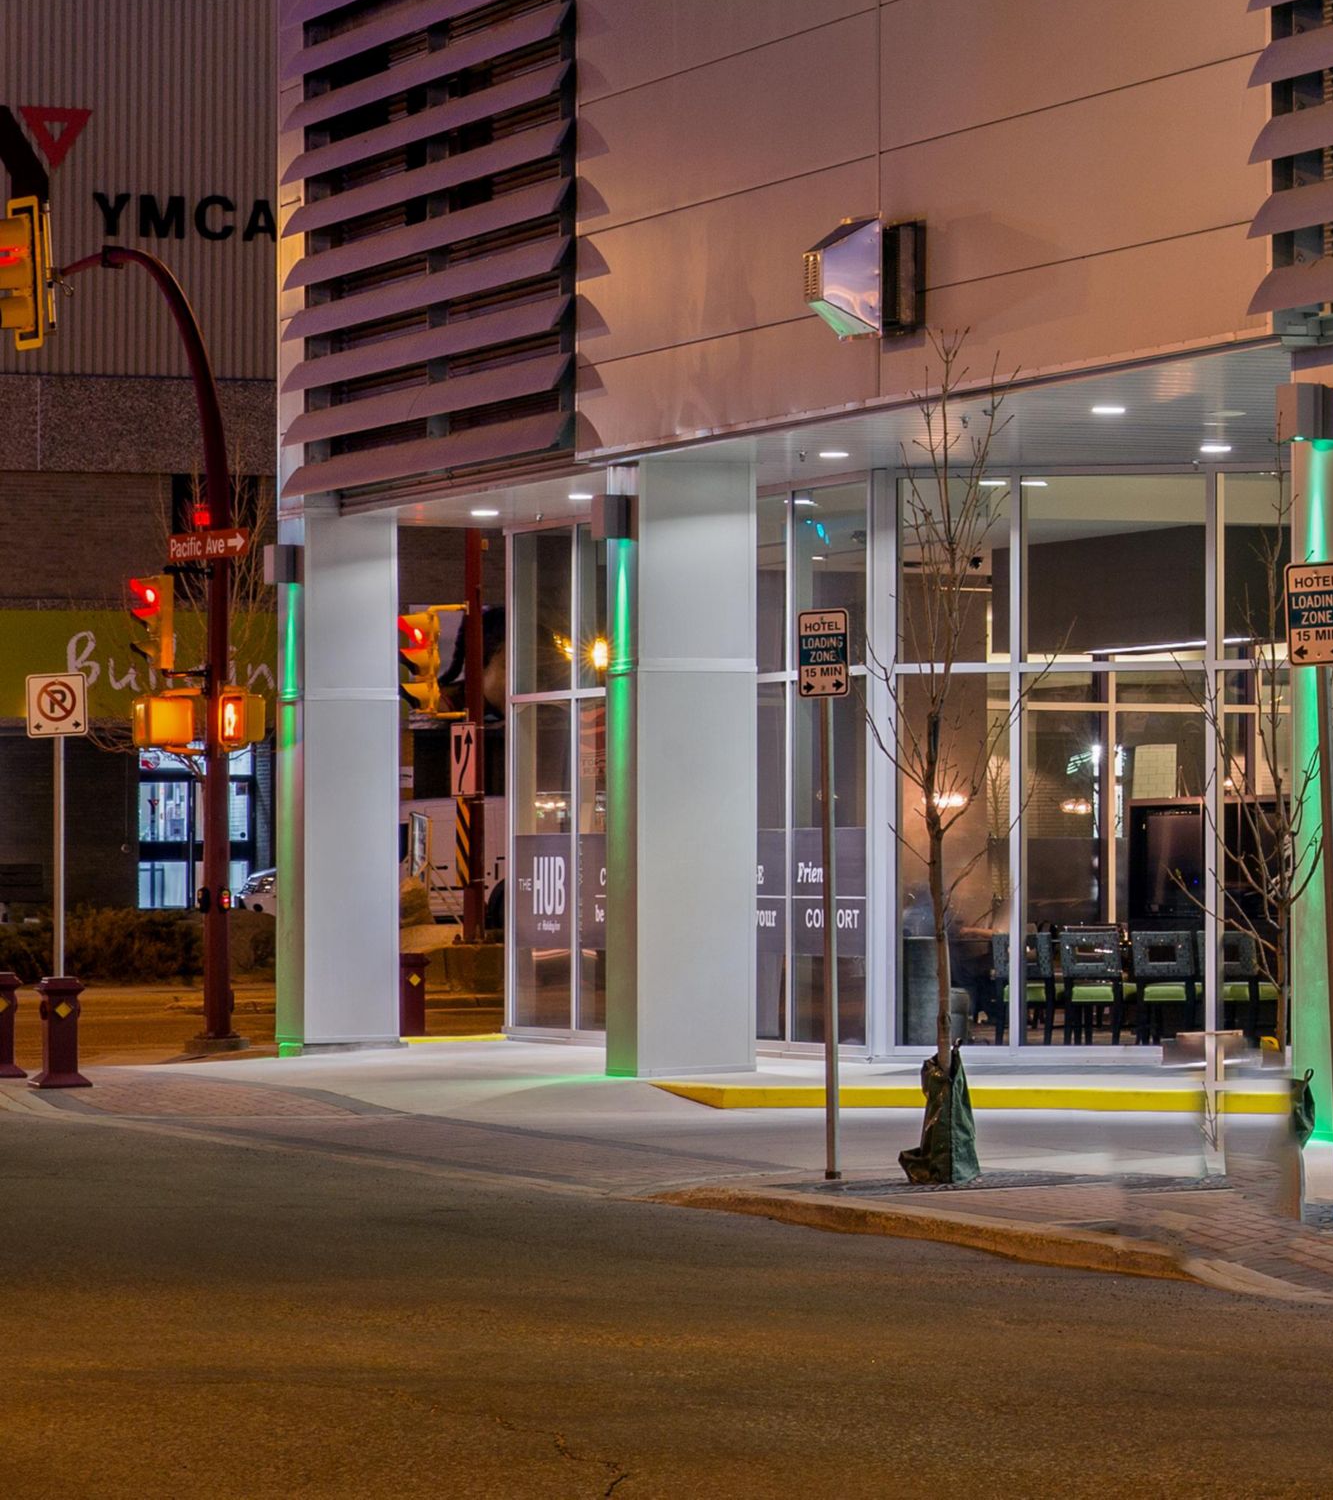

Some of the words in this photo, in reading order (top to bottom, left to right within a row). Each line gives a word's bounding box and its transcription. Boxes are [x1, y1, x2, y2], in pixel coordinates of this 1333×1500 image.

[92, 191, 277, 243] YMCA
[170, 536, 202, 559] Pacific
[205, 536, 225, 554] Ave
[1301, 610, 1333, 625] ZONE
[804, 621, 841, 633] HOTEL
[802, 635, 844, 650] LOADING
[1296, 630, 1311, 642] 15
[809, 650, 837, 663] ZONE
[804, 667, 817, 678] 15
[820, 666, 843, 677] MIN
[797, 861, 824, 883] Frien
[518, 878, 532, 891] THE
[532, 856, 566, 916] HUB
[757, 909, 777, 927] our
[805, 908, 860, 929] COORT
